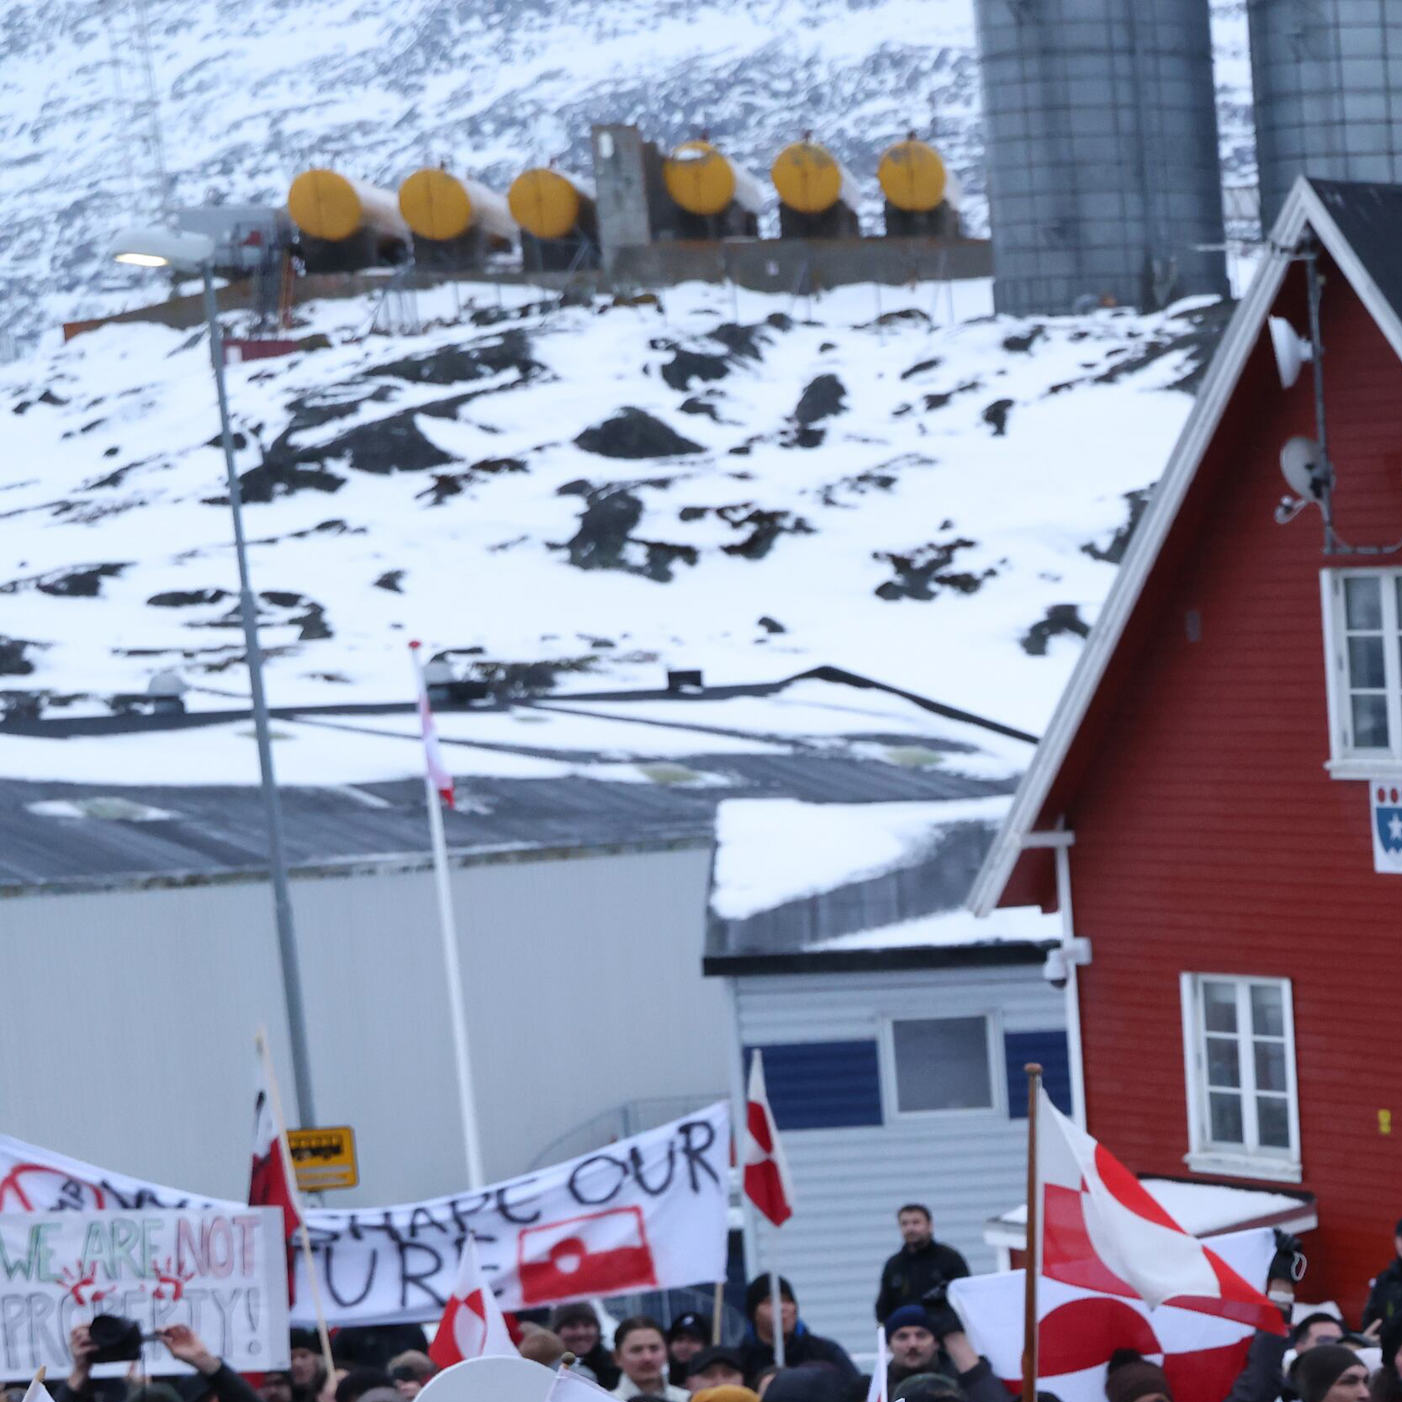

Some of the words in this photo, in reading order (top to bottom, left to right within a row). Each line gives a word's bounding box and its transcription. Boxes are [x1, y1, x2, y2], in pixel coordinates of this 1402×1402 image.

[569, 1119, 720, 1205] OUR
[0, 1222, 64, 1283] WE
[81, 1217, 165, 1281] ARE
[176, 1214, 262, 1279] NOT
[0, 1286, 262, 1370] PRORTY!
